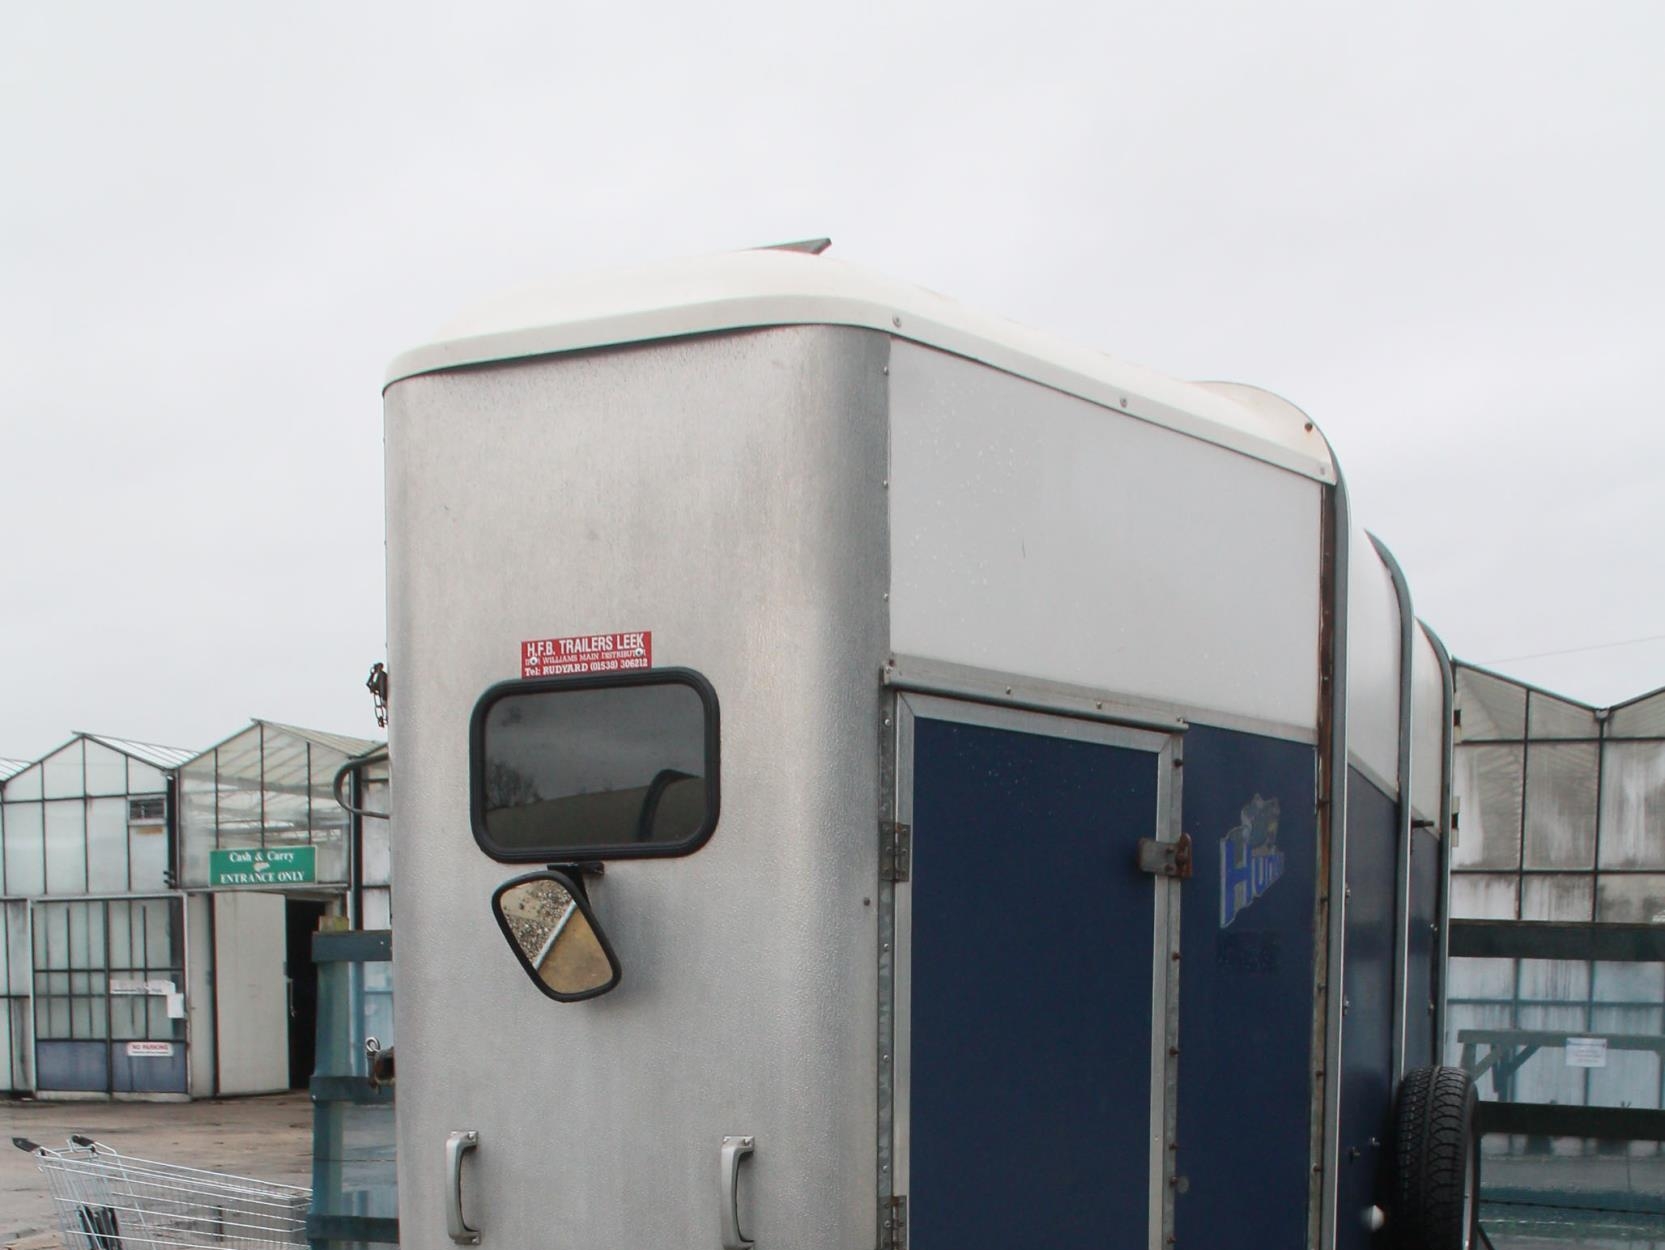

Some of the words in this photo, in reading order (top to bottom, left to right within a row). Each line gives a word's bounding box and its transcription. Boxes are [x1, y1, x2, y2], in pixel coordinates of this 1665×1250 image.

[527, 641, 556, 657] H.F.B.
[559, 636, 613, 655] TRAILERS
[617, 633, 644, 649] LEEK
[543, 654, 577, 665] WILLIAMS
[579, 652, 599, 661] MAIN
[601, 649, 646, 660] DISTRIBUT
[524, 667, 540, 677] Tel:
[543, 663, 588, 675] RUDYARD
[620, 658, 648, 669] 306212
[229, 852, 251, 863] Cash
[255, 852, 263, 862] &
[267, 851, 294, 863] Carry
[220, 872, 274, 884] ENTRANCE
[277, 871, 305, 881] ONLY
